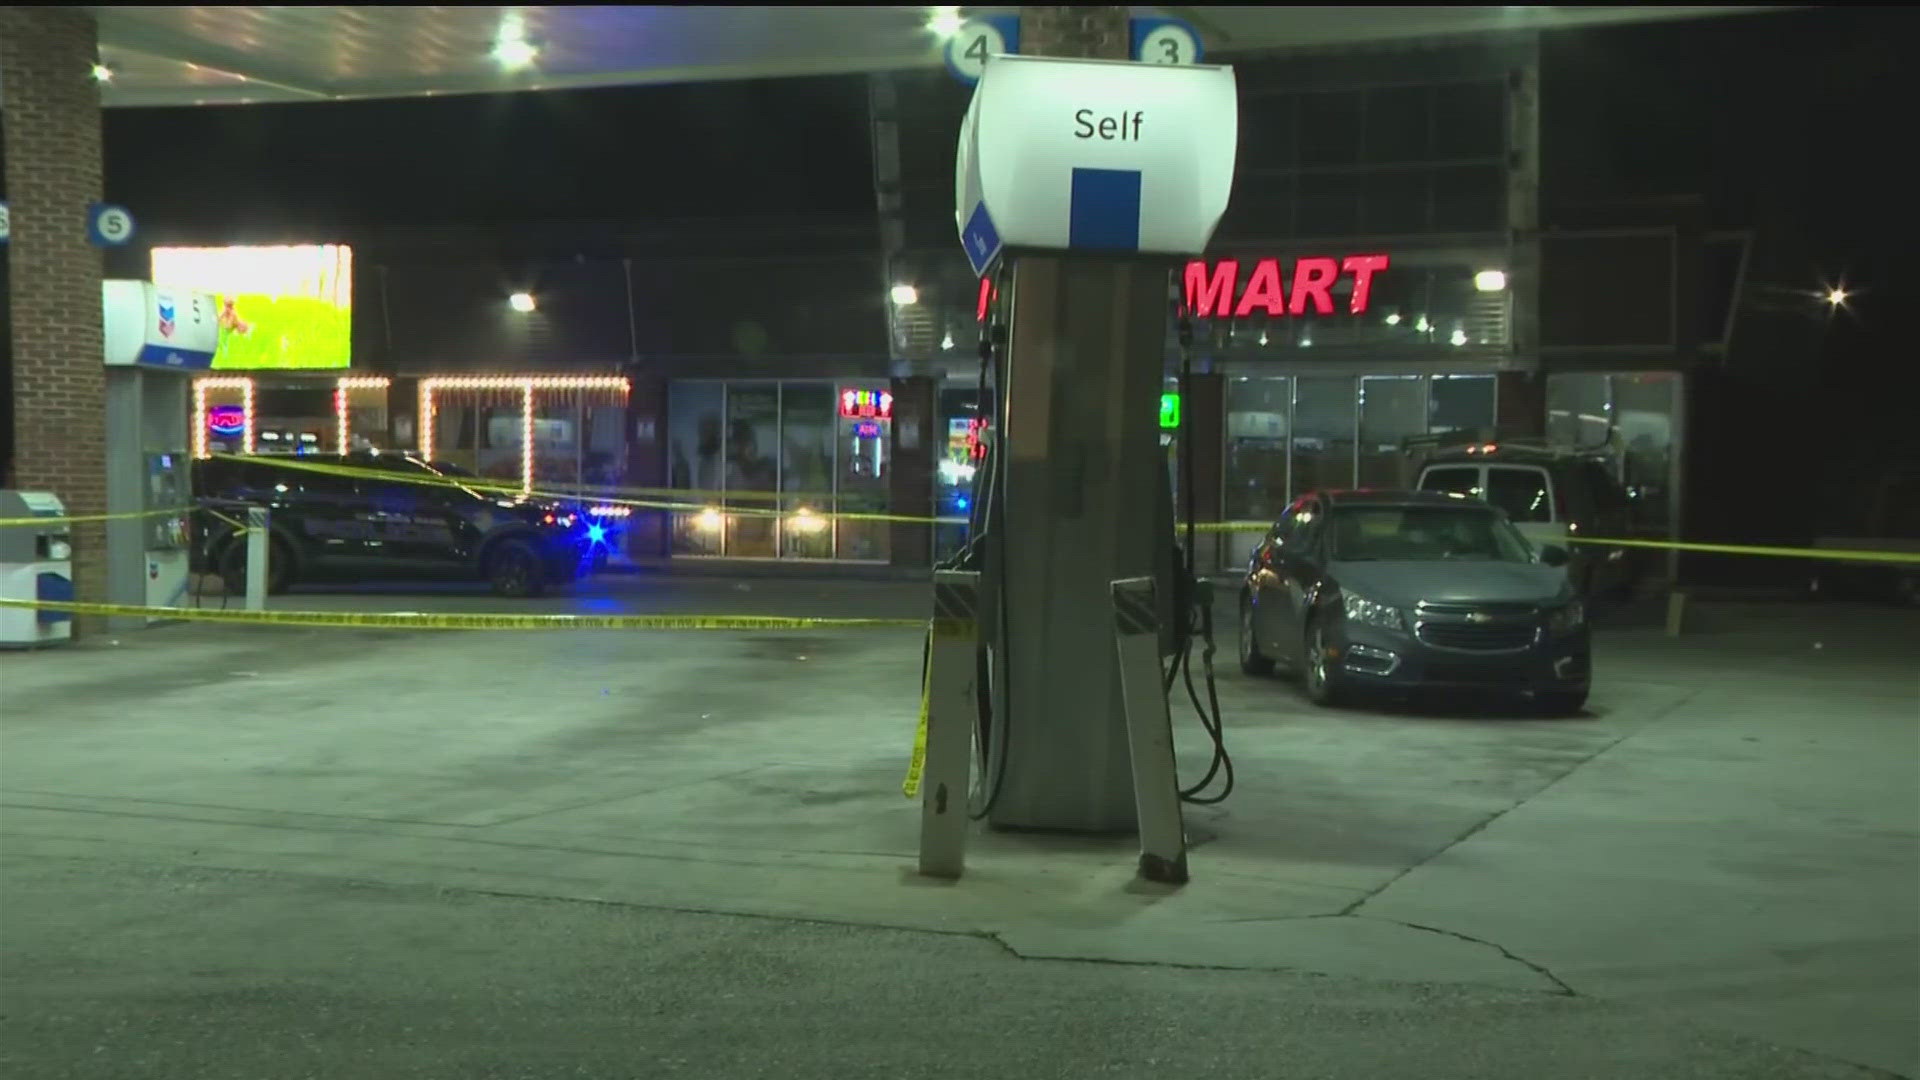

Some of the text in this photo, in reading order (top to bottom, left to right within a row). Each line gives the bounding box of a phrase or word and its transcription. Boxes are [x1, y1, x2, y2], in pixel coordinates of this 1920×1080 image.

[964, 34, 989, 65] 4
[1158, 38, 1180, 65] 3
[1074, 109, 1144, 141] Self
[106, 214, 123, 235] 5
[1184, 254, 1390, 317] MART
